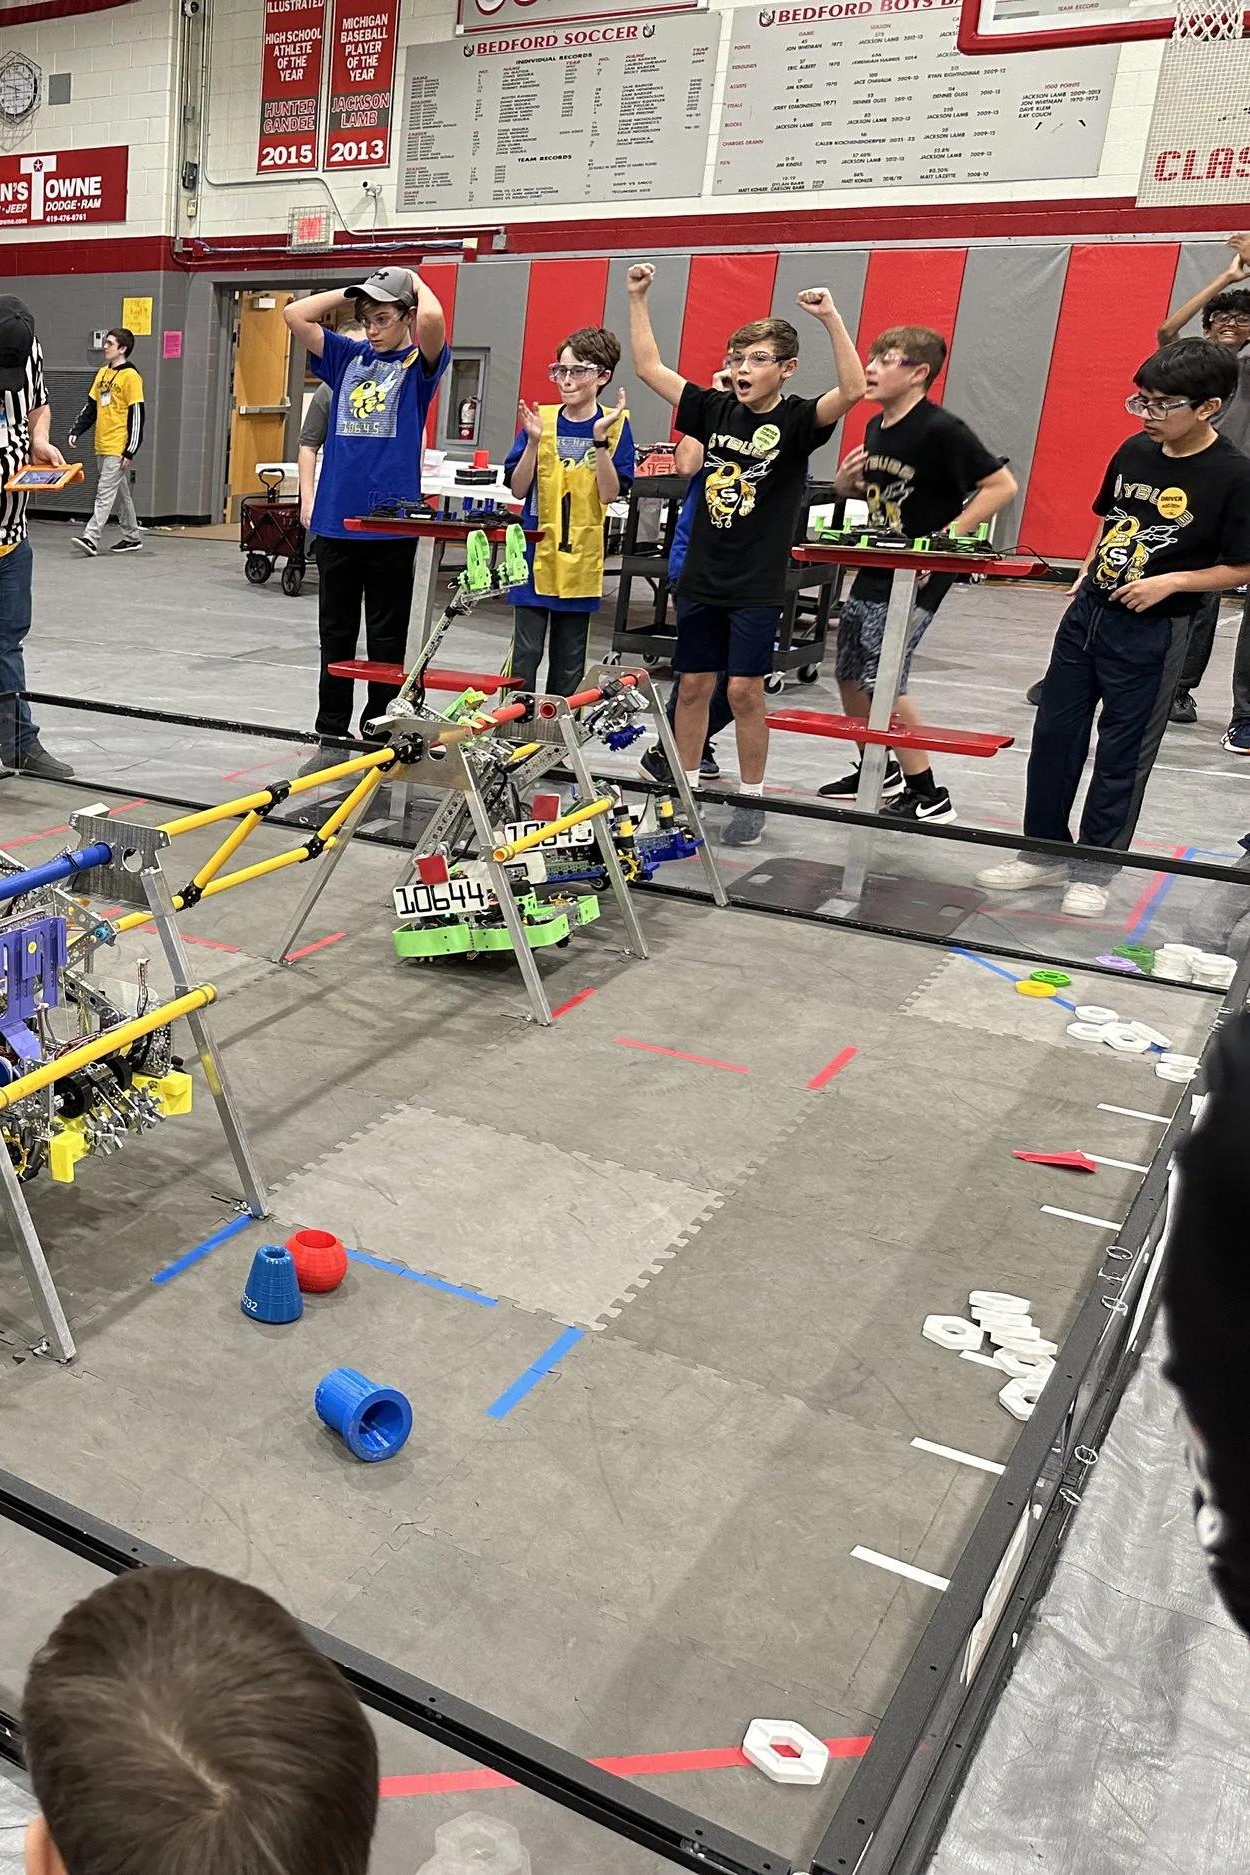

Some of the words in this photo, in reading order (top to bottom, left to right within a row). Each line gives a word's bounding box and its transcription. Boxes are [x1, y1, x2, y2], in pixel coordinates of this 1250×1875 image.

[266, 0, 324, 13] ILLUSTRATED
[778, 1, 872, 23] BEDFORD
[880, 0, 940, 12] BOYS
[342, 14, 388, 30] MICHIGAN
[266, 32, 285, 44] HIGH
[287, 28, 322, 42] SCHOOL
[340, 27, 388, 44] BASEBALL
[476, 34, 558, 55] BEDFORD
[564, 26, 638, 46] SOCCER
[273, 42, 312, 56] ATHLETE
[345, 41, 382, 56] PLAYER
[278, 58, 288, 69] OF
[288, 56, 307, 68] THE
[347, 56, 359, 68] OF
[360, 54, 378, 66] THE
[516, 56, 556, 64] INDIVIDUAL
[559, 52, 592, 60] RECORDS
[280, 69, 304, 82] YEAR
[350, 68, 374, 82] YEAR
[264, 99, 316, 118] HUNTER
[332, 92, 390, 113] JACKSON
[264, 116, 314, 134] GANDEE
[340, 111, 378, 128] LAMB
[261, 144, 312, 166] 2015
[330, 140, 384, 162] 2013
[5, 204, 28, 214] JEEP
[46, 200, 77, 212] DODGE
[81, 198, 101, 208] RAM
[558, 492, 572, 554] 1
[1110, 548, 1128, 566] S
[396, 880, 485, 916] 10644
